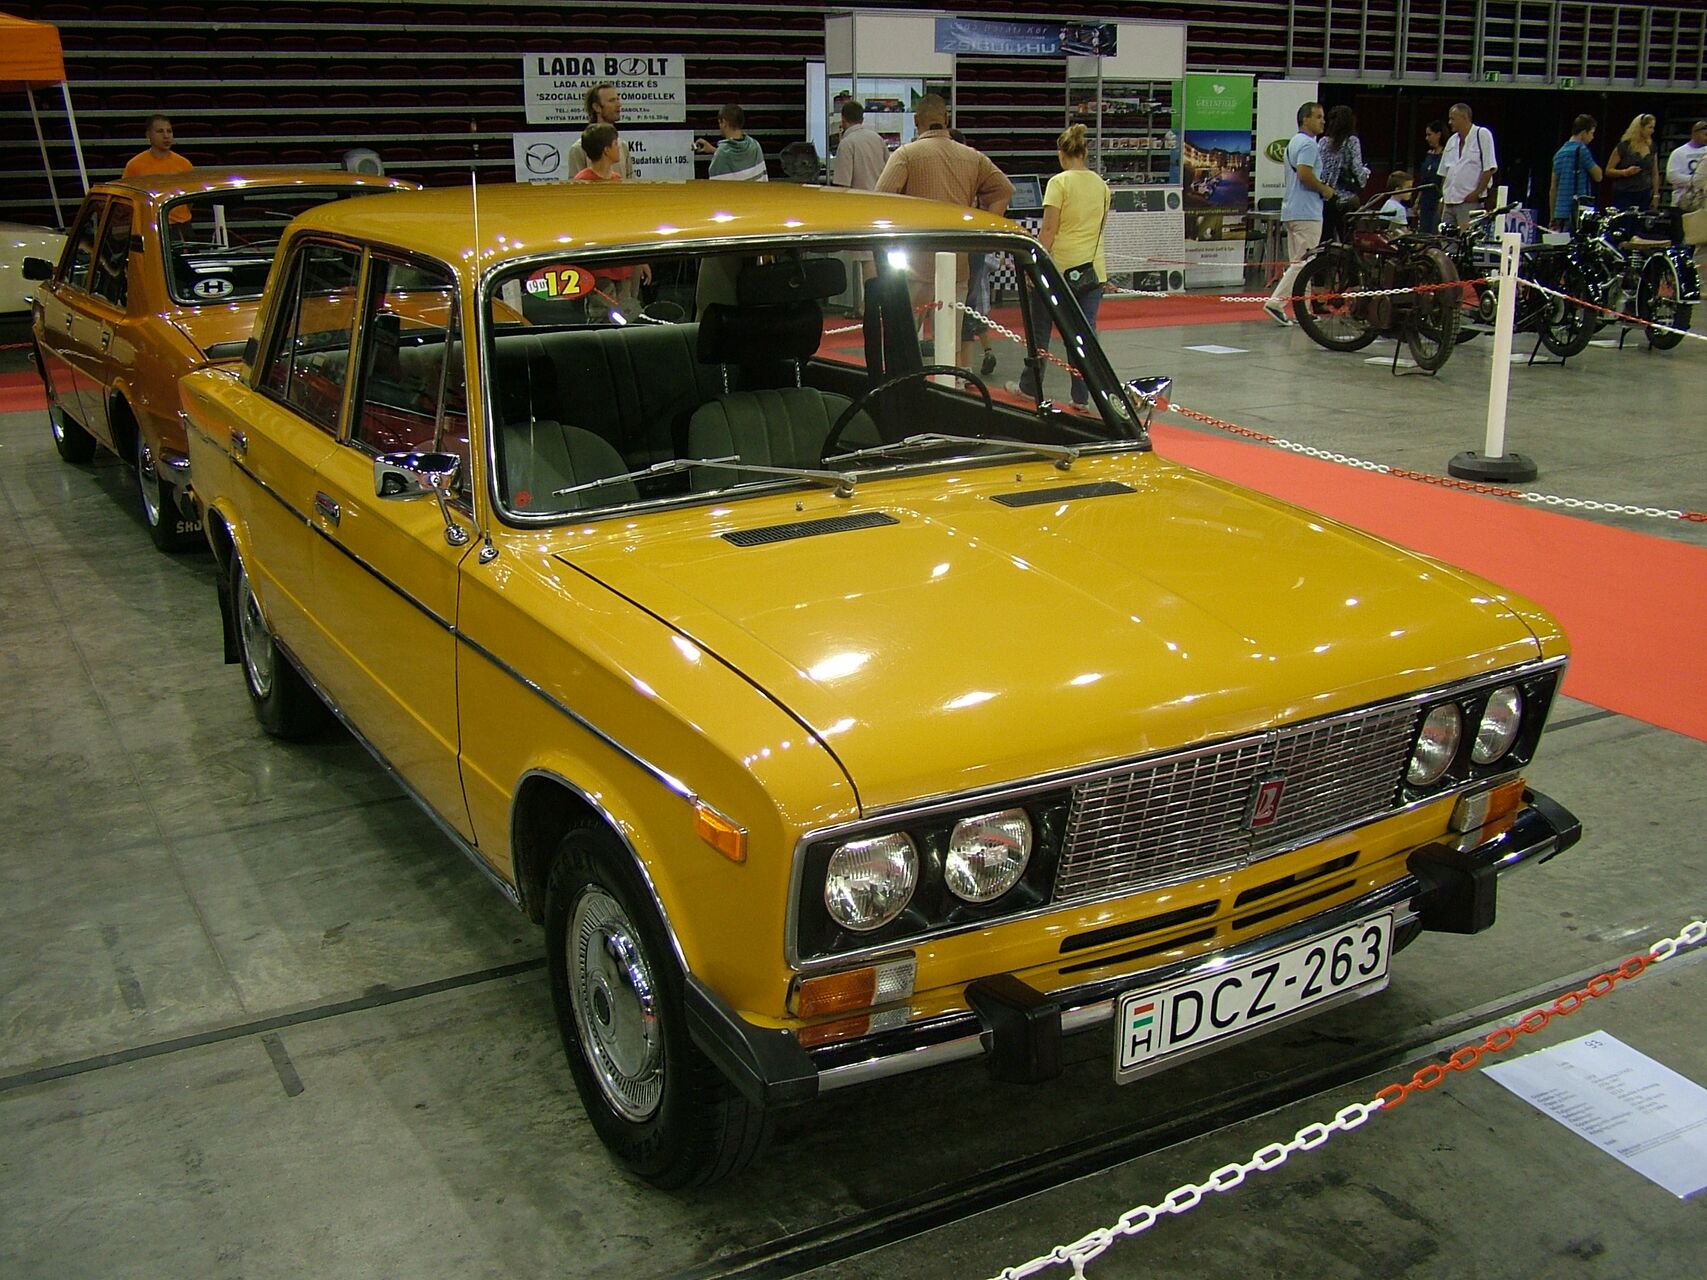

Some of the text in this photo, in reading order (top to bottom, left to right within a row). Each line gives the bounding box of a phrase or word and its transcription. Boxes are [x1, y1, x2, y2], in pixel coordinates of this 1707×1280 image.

[538, 57, 595, 76] LADA
[553, 80, 577, 88] LADA
[647, 79, 658, 88] ÉS
[628, 141, 647, 152] Kft.
[665, 155, 673, 164] út
[675, 155, 689, 164] 105.
[203, 281, 224, 293] H
[545, 270, 580, 297] 12
[1169, 925, 1382, 1044] DCZ-263
[1130, 1029, 1152, 1057] H
